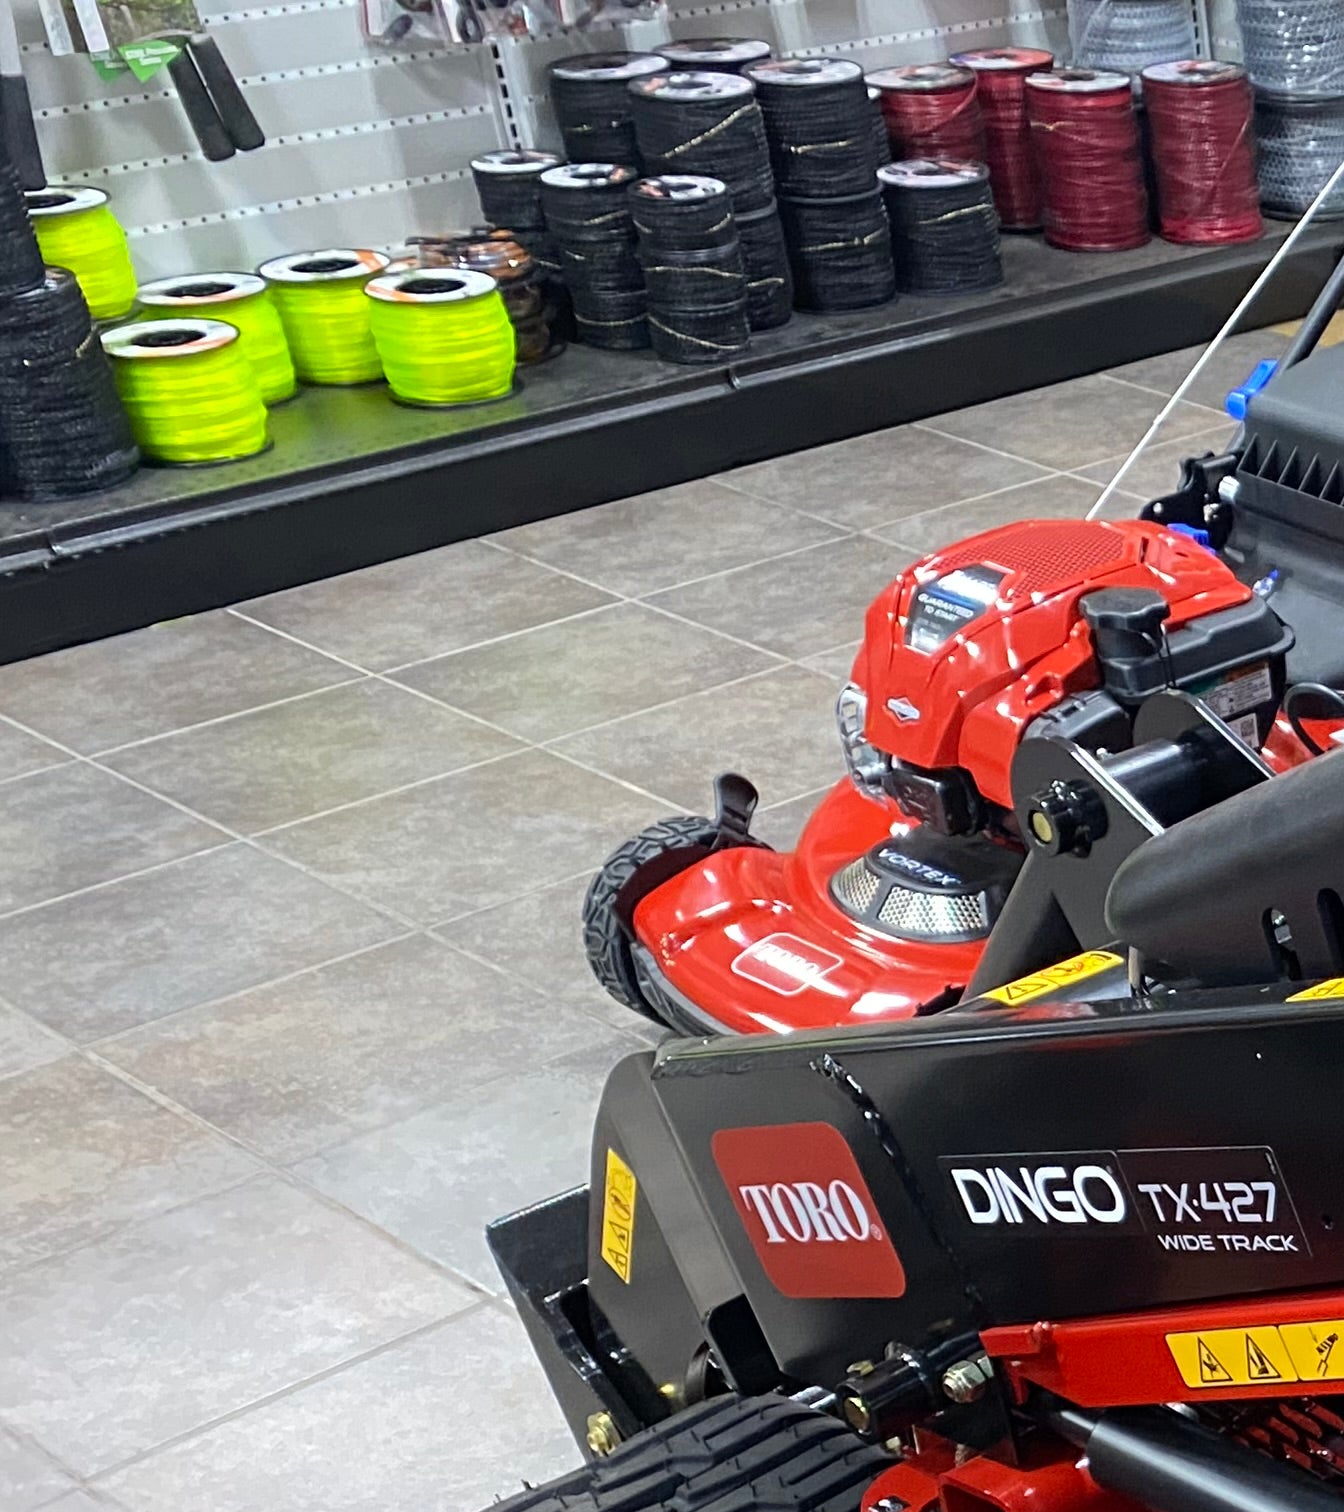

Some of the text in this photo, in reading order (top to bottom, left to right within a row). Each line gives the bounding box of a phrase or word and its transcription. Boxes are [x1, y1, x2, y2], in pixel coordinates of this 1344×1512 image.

[878, 848, 957, 886] VORTEX
[740, 1179, 873, 1244] TORO
[951, 1165, 1127, 1224] DINGO
[1157, 1234, 1299, 1252] WIDE TRACK
